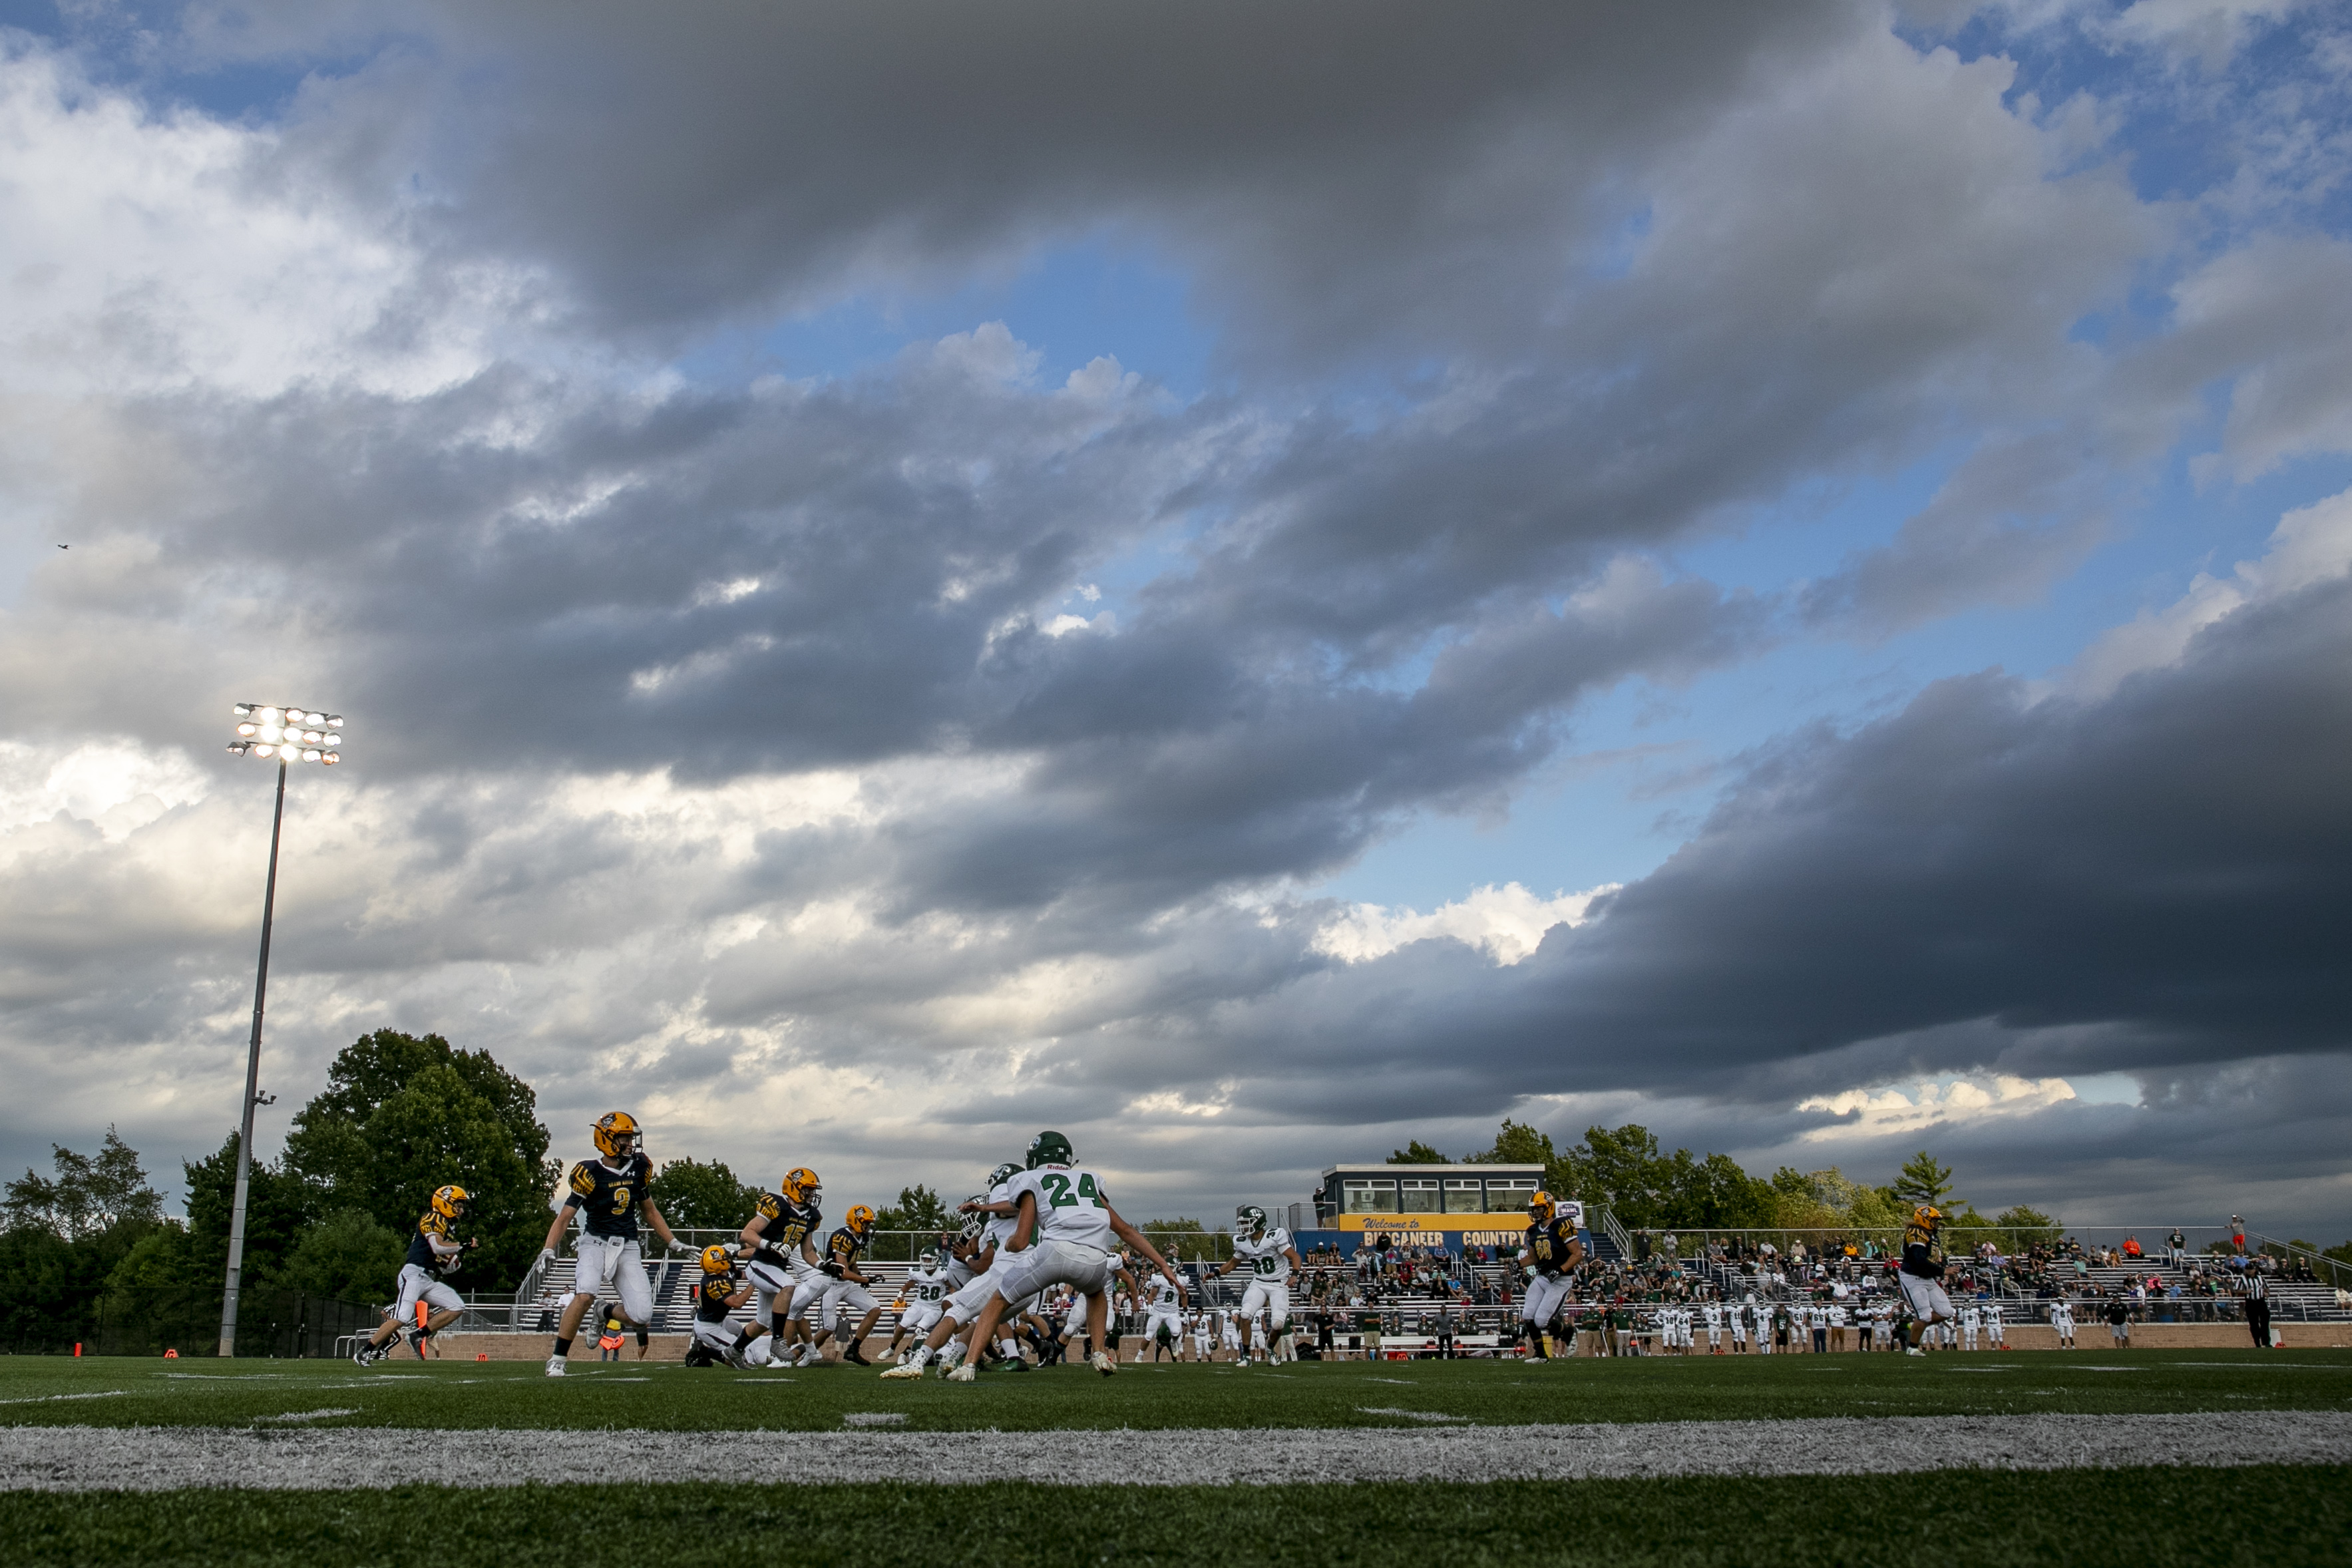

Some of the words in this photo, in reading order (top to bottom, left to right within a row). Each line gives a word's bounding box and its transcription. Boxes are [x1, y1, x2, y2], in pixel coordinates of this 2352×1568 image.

[611, 1187, 630, 1215] 3
[1040, 1173, 1107, 1211] 24
[1362, 1218, 1406, 1229] Welcome
[1408, 1219, 1420, 1229] to
[783, 1224, 807, 1249] 15
[1364, 1231, 1444, 1247] BUCANEER
[1463, 1231, 1526, 1247] COUNTRY
[1535, 1239, 1552, 1260] 68
[1164, 1290, 1175, 1303] 8
[1665, 1316, 1674, 1325] 10
